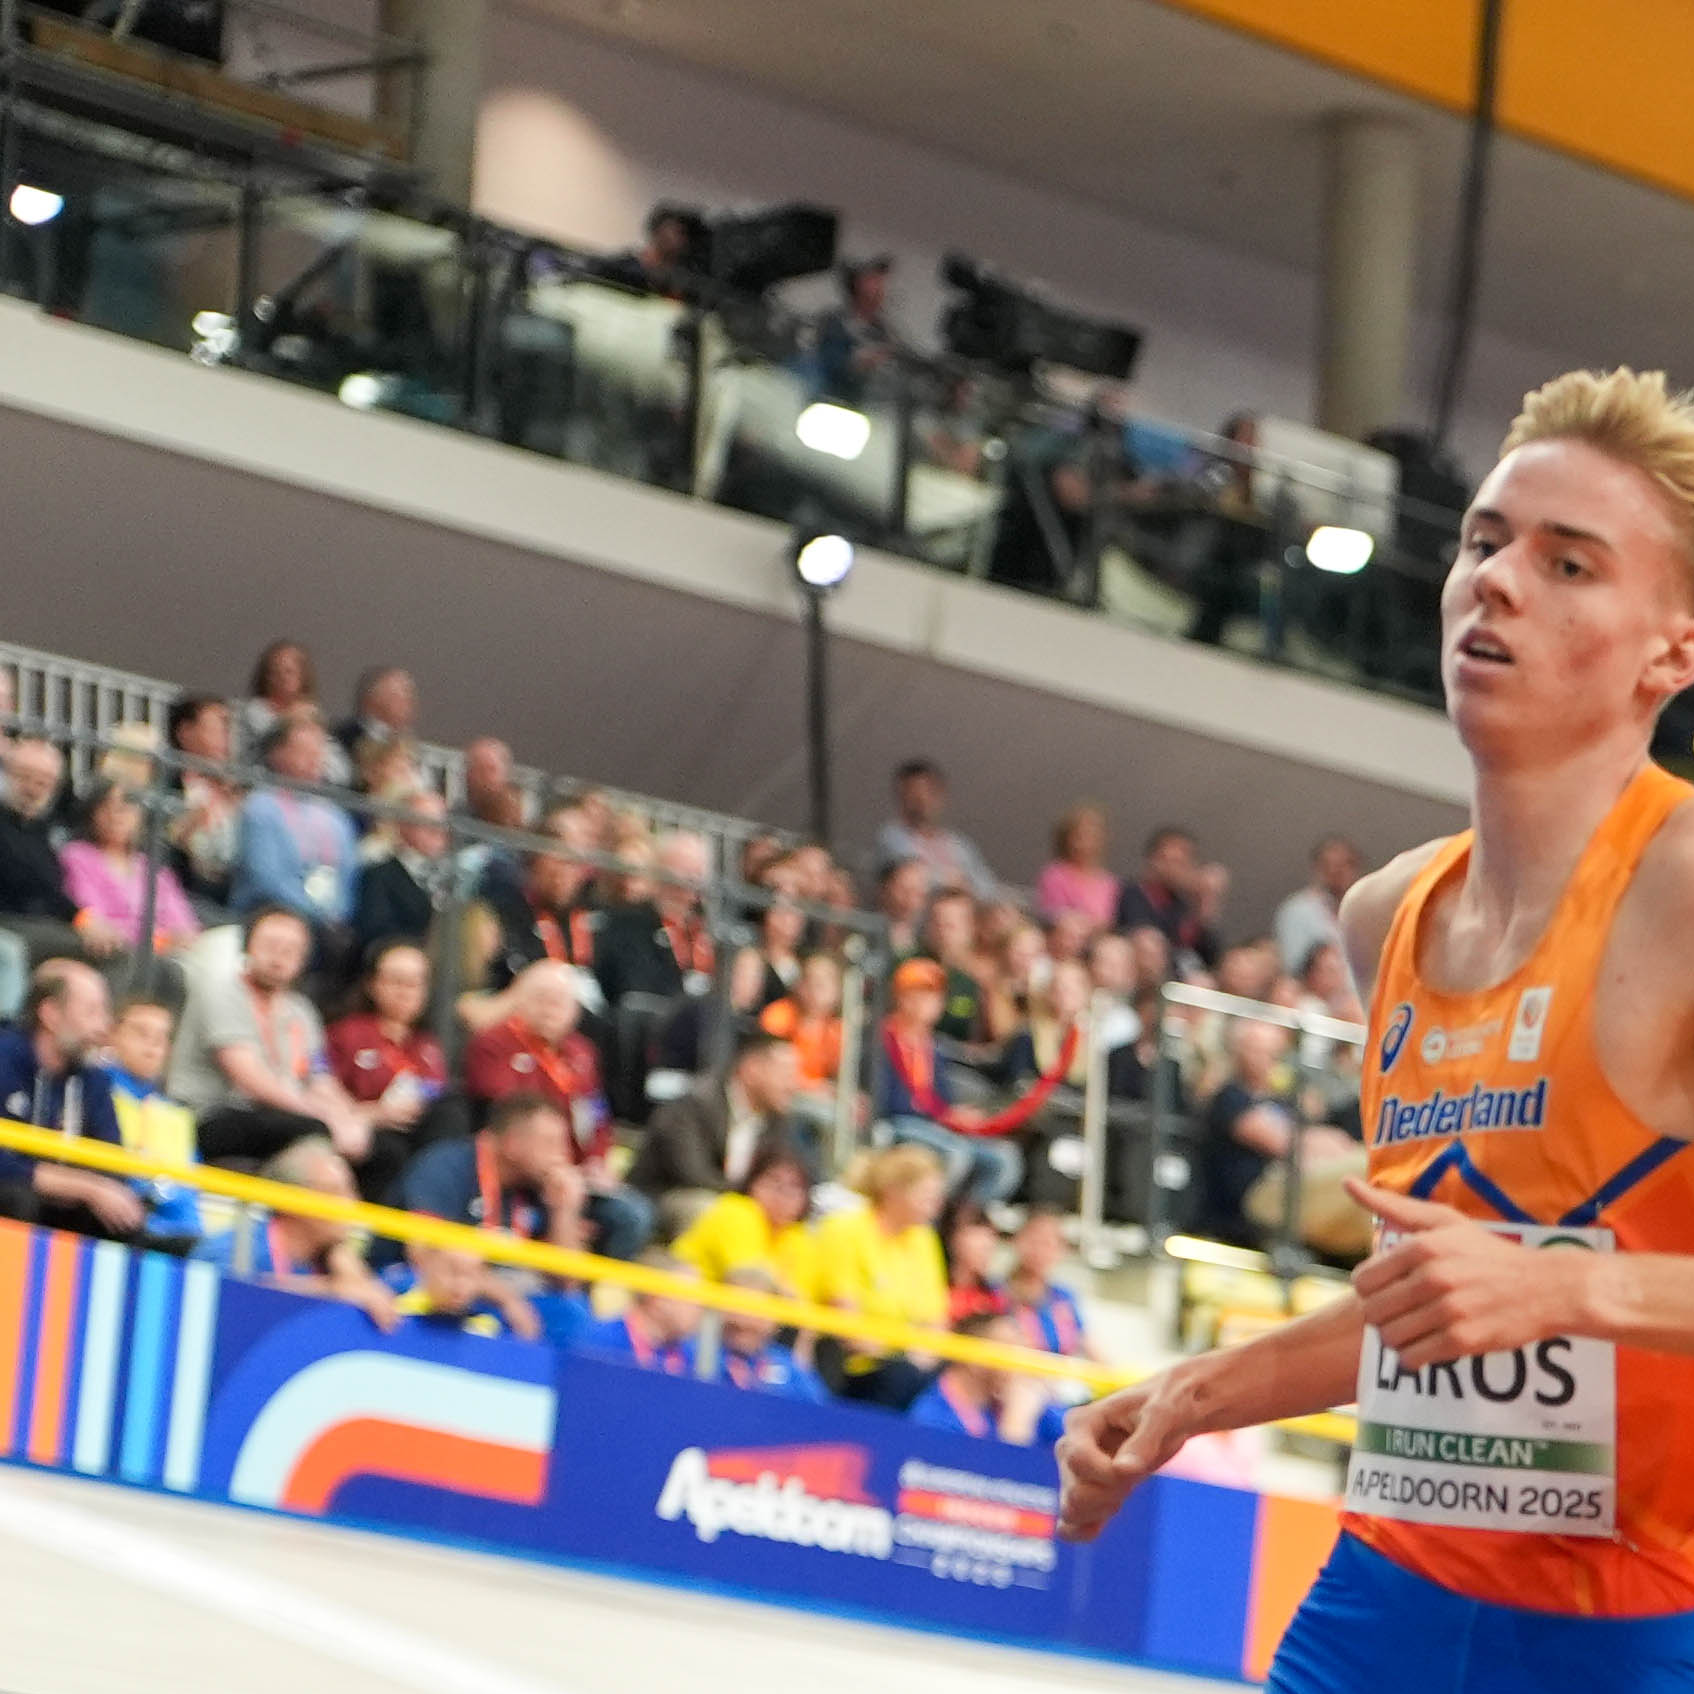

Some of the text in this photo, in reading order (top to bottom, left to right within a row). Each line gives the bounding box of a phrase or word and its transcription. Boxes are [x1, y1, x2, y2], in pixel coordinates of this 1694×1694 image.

[1393, 1430, 1435, 1459] RUN
[1354, 1469, 1602, 1519] APELDOORN 2025
